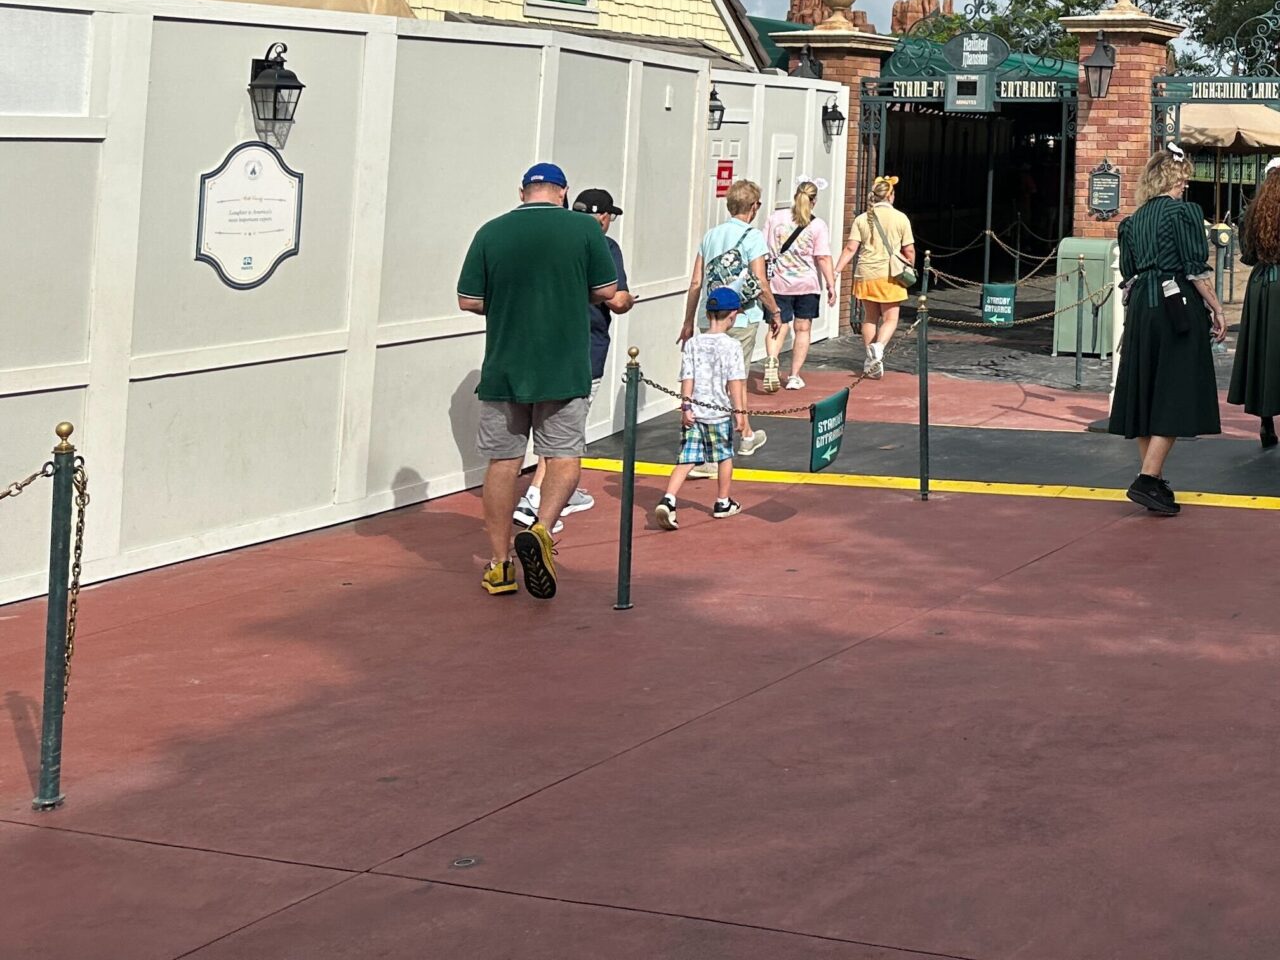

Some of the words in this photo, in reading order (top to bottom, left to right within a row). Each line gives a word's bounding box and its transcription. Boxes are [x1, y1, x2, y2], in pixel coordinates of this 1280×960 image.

[963, 37, 988, 51] Haunted
[961, 52, 988, 67] Mansion
[1001, 81, 1057, 97] ENTRANCE
[1192, 82, 1247, 98] LIGHTNING
[1252, 82, 1279, 98] LANE
